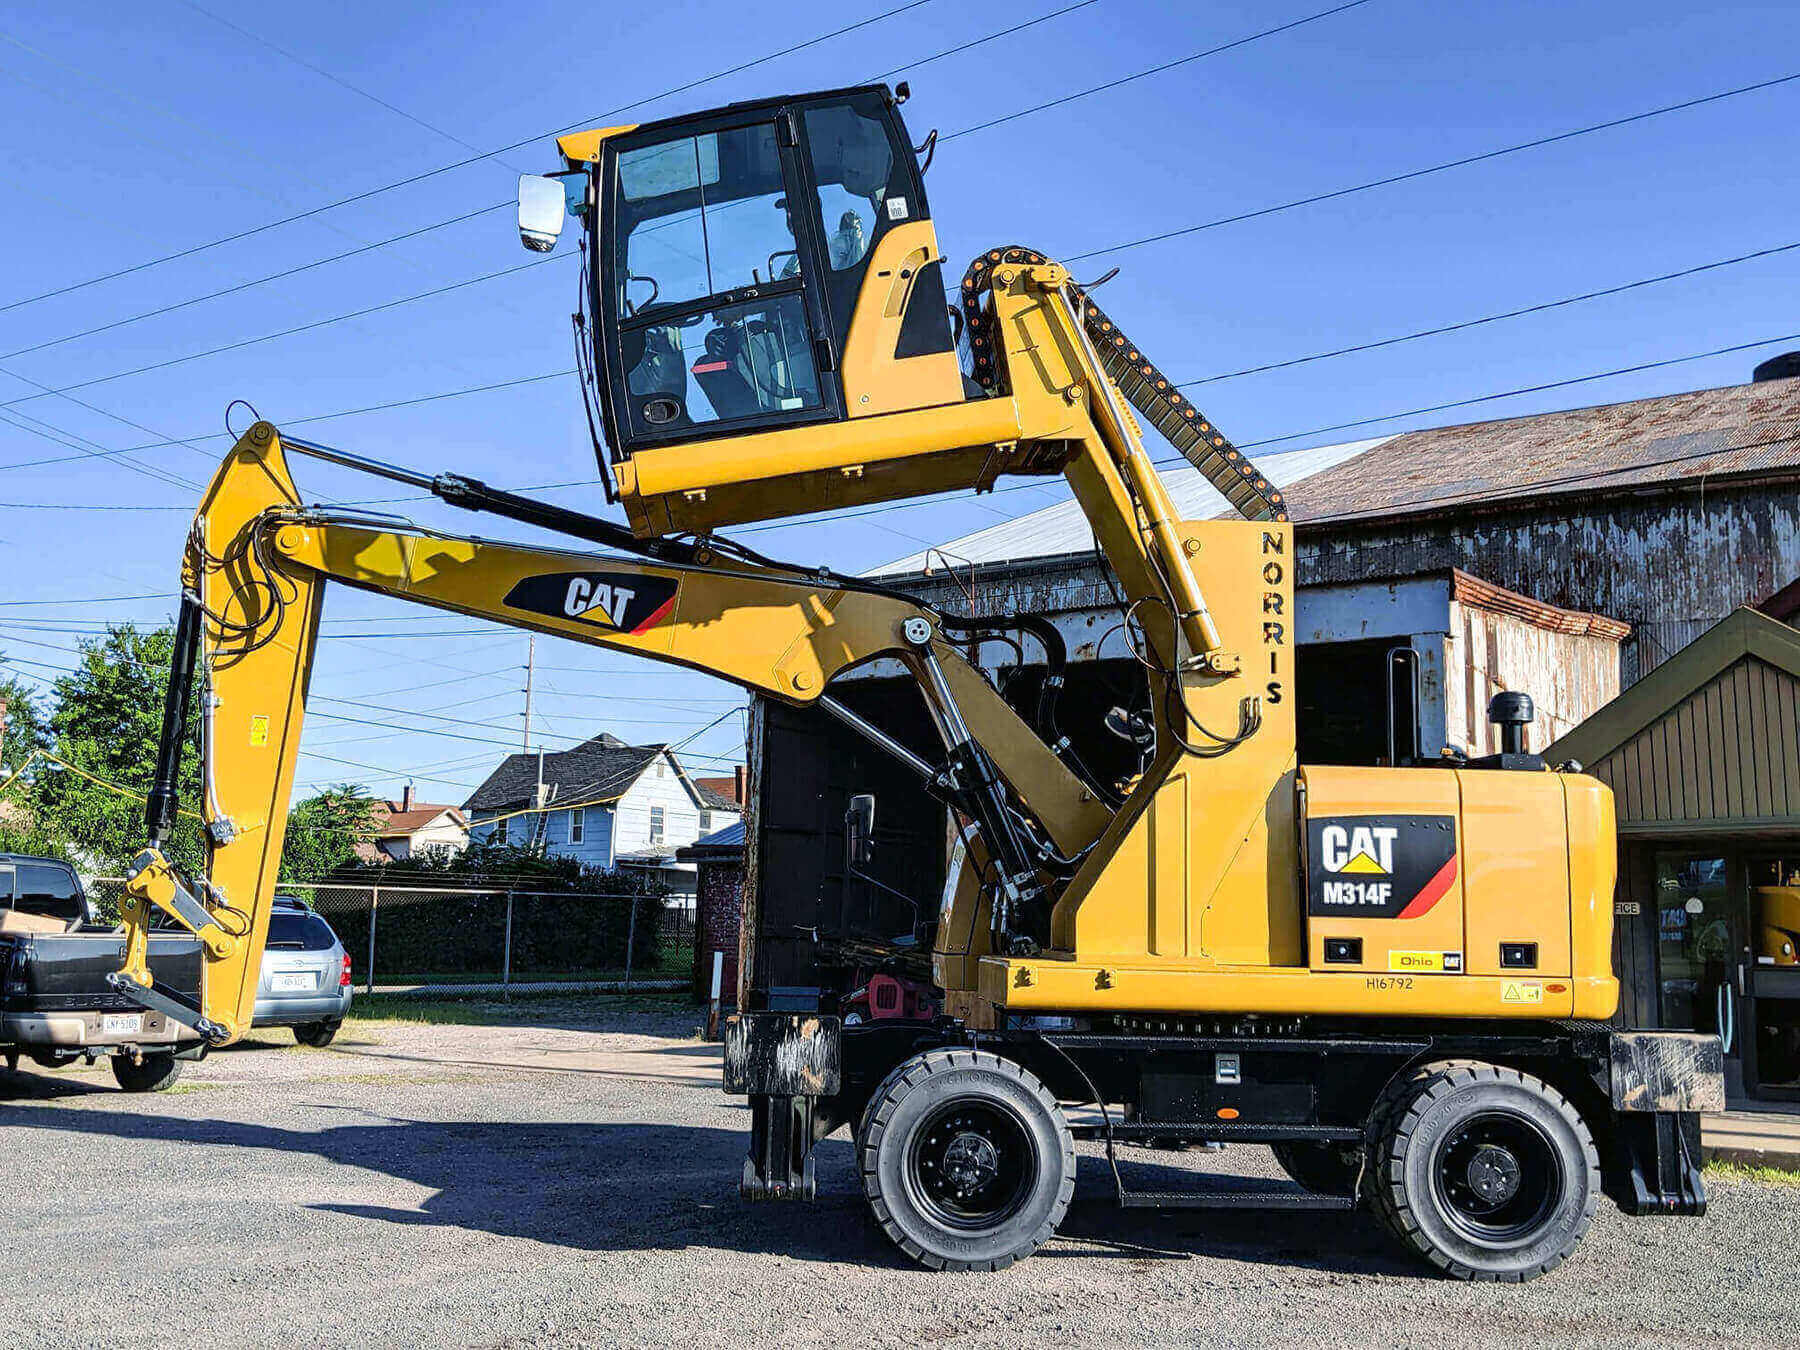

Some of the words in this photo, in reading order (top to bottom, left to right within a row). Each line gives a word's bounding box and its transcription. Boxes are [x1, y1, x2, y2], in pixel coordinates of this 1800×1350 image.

[564, 577, 635, 628] CAT
[1262, 531, 1284, 704] NORRIS
[1322, 826, 1398, 873] CAT
[1323, 881, 1392, 905] M314F
[1400, 956, 1433, 966] Ohio
